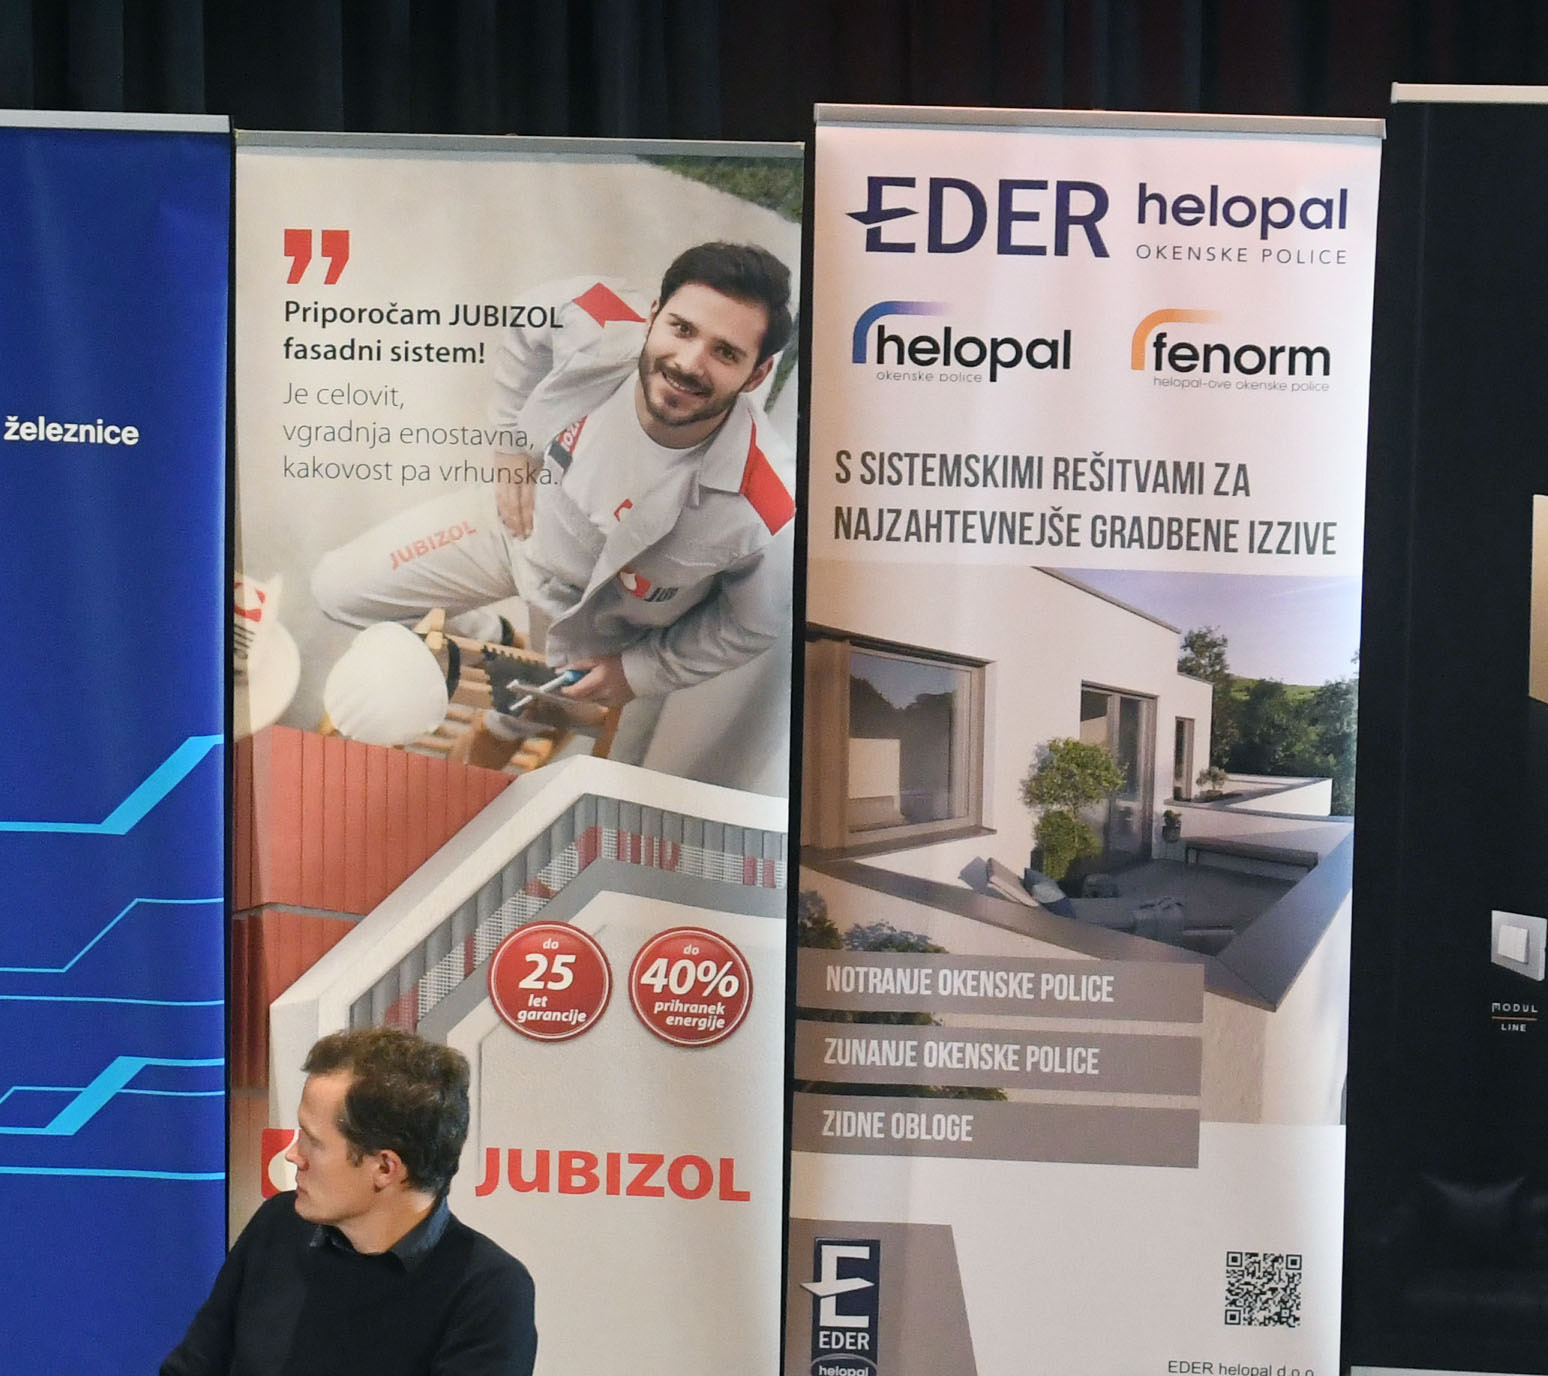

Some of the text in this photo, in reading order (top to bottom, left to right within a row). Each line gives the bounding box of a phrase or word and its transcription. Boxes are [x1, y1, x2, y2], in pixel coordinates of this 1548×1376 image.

[846, 176, 1111, 258] EDER
[1138, 183, 1348, 240] helopal
[1136, 245, 1347, 265] OKENSKE POLICE
[284, 300, 564, 330] Priporočam JUBIZOL
[283, 337, 486, 364] fasadni sistem!
[877, 324, 1072, 382] helopal
[1153, 332, 1331, 376] fenorm
[876, 369, 934, 382] okenske
[282, 382, 404, 410] Je celovit,
[4, 415, 140, 446] železnice
[282, 420, 391, 447] vgradnja
[399, 427, 535, 451] enostavna,
[283, 455, 560, 487] kakovost pa vrhunska.
[835, 450, 1251, 497] S SISTEMSKIMI REŠITVAMI ZA
[389, 520, 478, 571] JUBIZOL
[834, 506, 1337, 555] NAJZAHTEVNEJŠE GRADBENE IZZIVE
[543, 939, 559, 950] do
[683, 945, 700, 956] do
[519, 953, 577, 991] 25
[640, 958, 740, 999] 40%
[826, 965, 1114, 1002] NOTRANJE OKENSKE POLICE
[528, 994, 548, 1008] let
[653, 1000, 726, 1016] prihranek
[517, 1009, 587, 1025] garancije
[665, 1016, 726, 1031] energije
[1501, 1024, 1526, 1032] LINE
[824, 1038, 1099, 1074] ZUNANJE OKENSKE POLICE
[822, 1110, 974, 1141] ZIDNE OBLOGE
[475, 1147, 751, 1202] JUBIZOL
[819, 1331, 870, 1350] EDER
[1168, 1360, 1213, 1374] EDER
